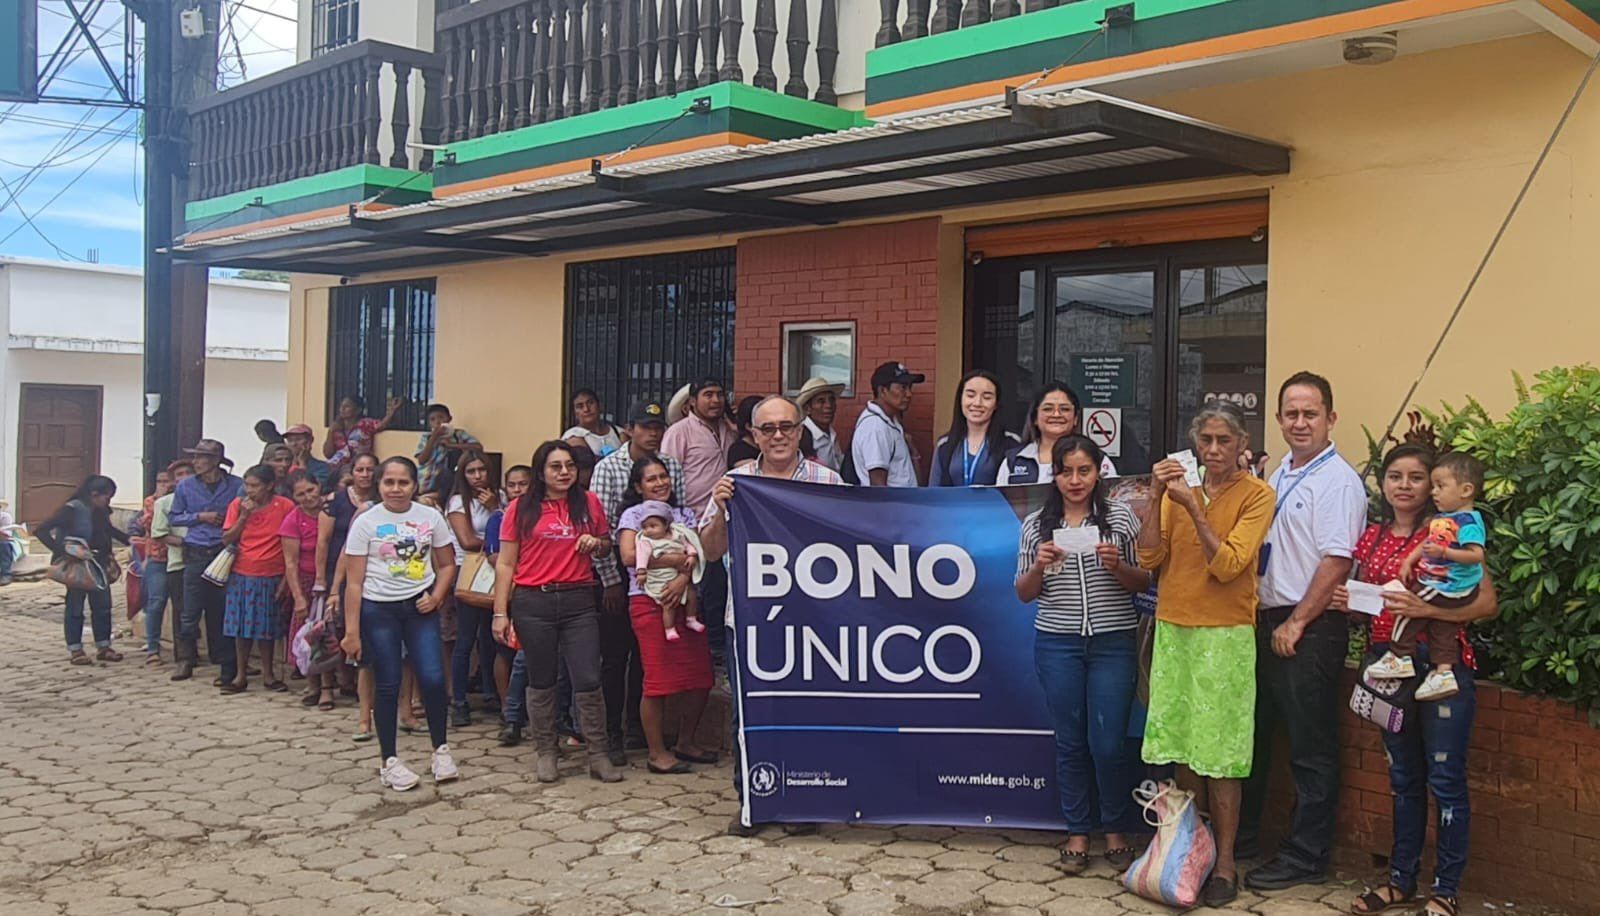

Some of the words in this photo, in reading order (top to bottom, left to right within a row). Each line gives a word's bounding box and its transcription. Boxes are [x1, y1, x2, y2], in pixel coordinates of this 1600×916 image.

[746, 542, 977, 600] BONO
[746, 605, 983, 683] ÚNICO
[787, 778, 824, 786] Desarrollo
[825, 777, 847, 786] Social
[938, 773, 1046, 790] www.mides.gob.gt
